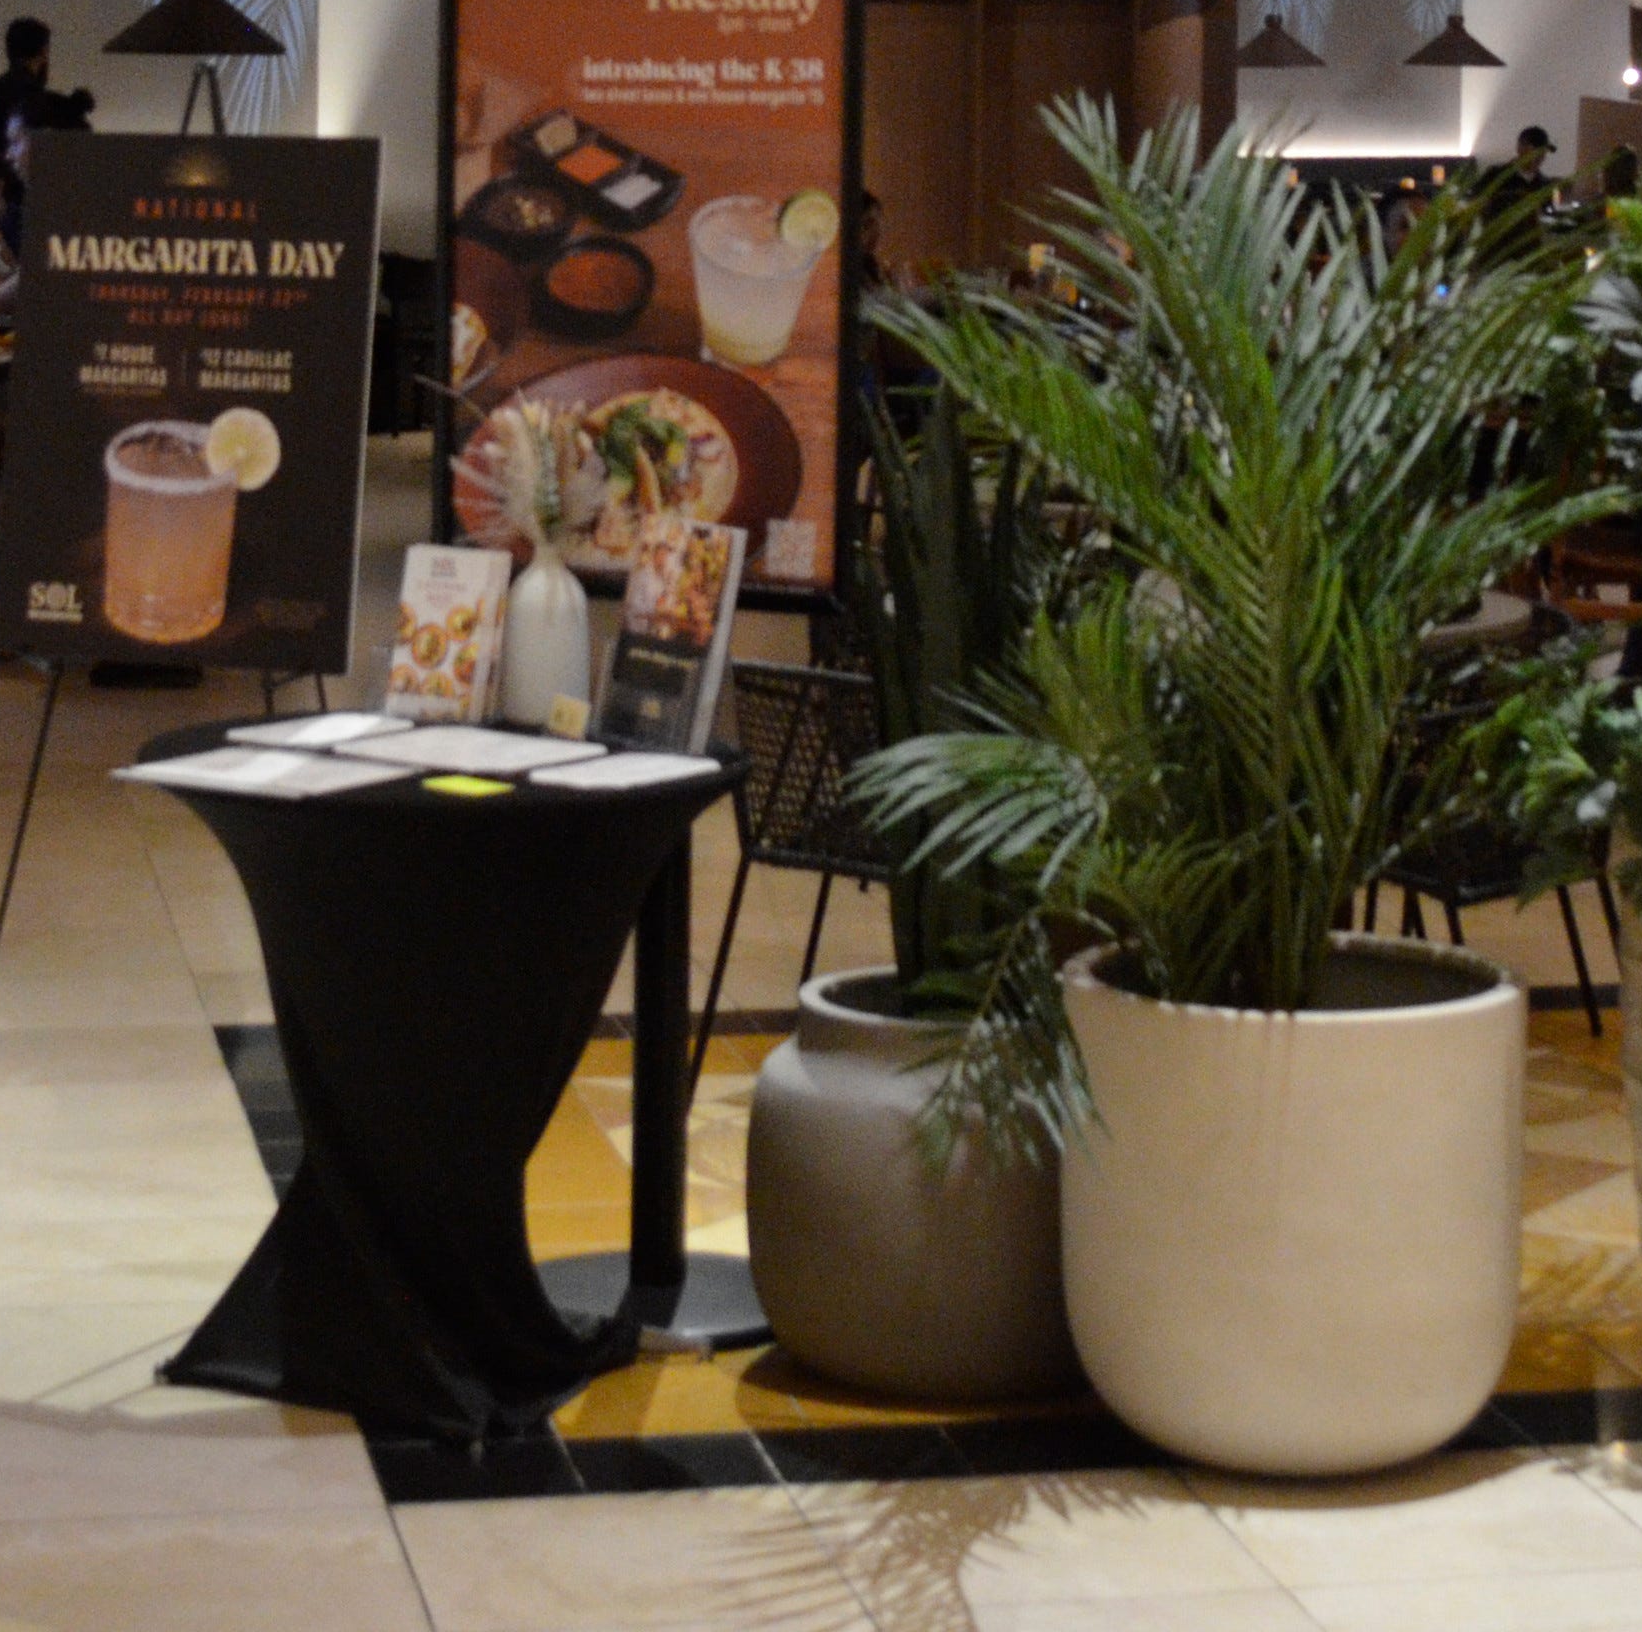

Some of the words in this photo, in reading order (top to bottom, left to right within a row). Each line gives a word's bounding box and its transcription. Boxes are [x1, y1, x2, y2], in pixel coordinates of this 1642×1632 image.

[720, 55, 760, 82] the
[134, 197, 258, 222] NATIONAL
[48, 235, 256, 276] MARGARITA
[268, 241, 345, 278] DAY
[223, 348, 293, 370] CADILLAC
[79, 365, 168, 387] MARGARITAS
[198, 370, 293, 393] MARGARITAS
[28, 581, 84, 610] SOL
